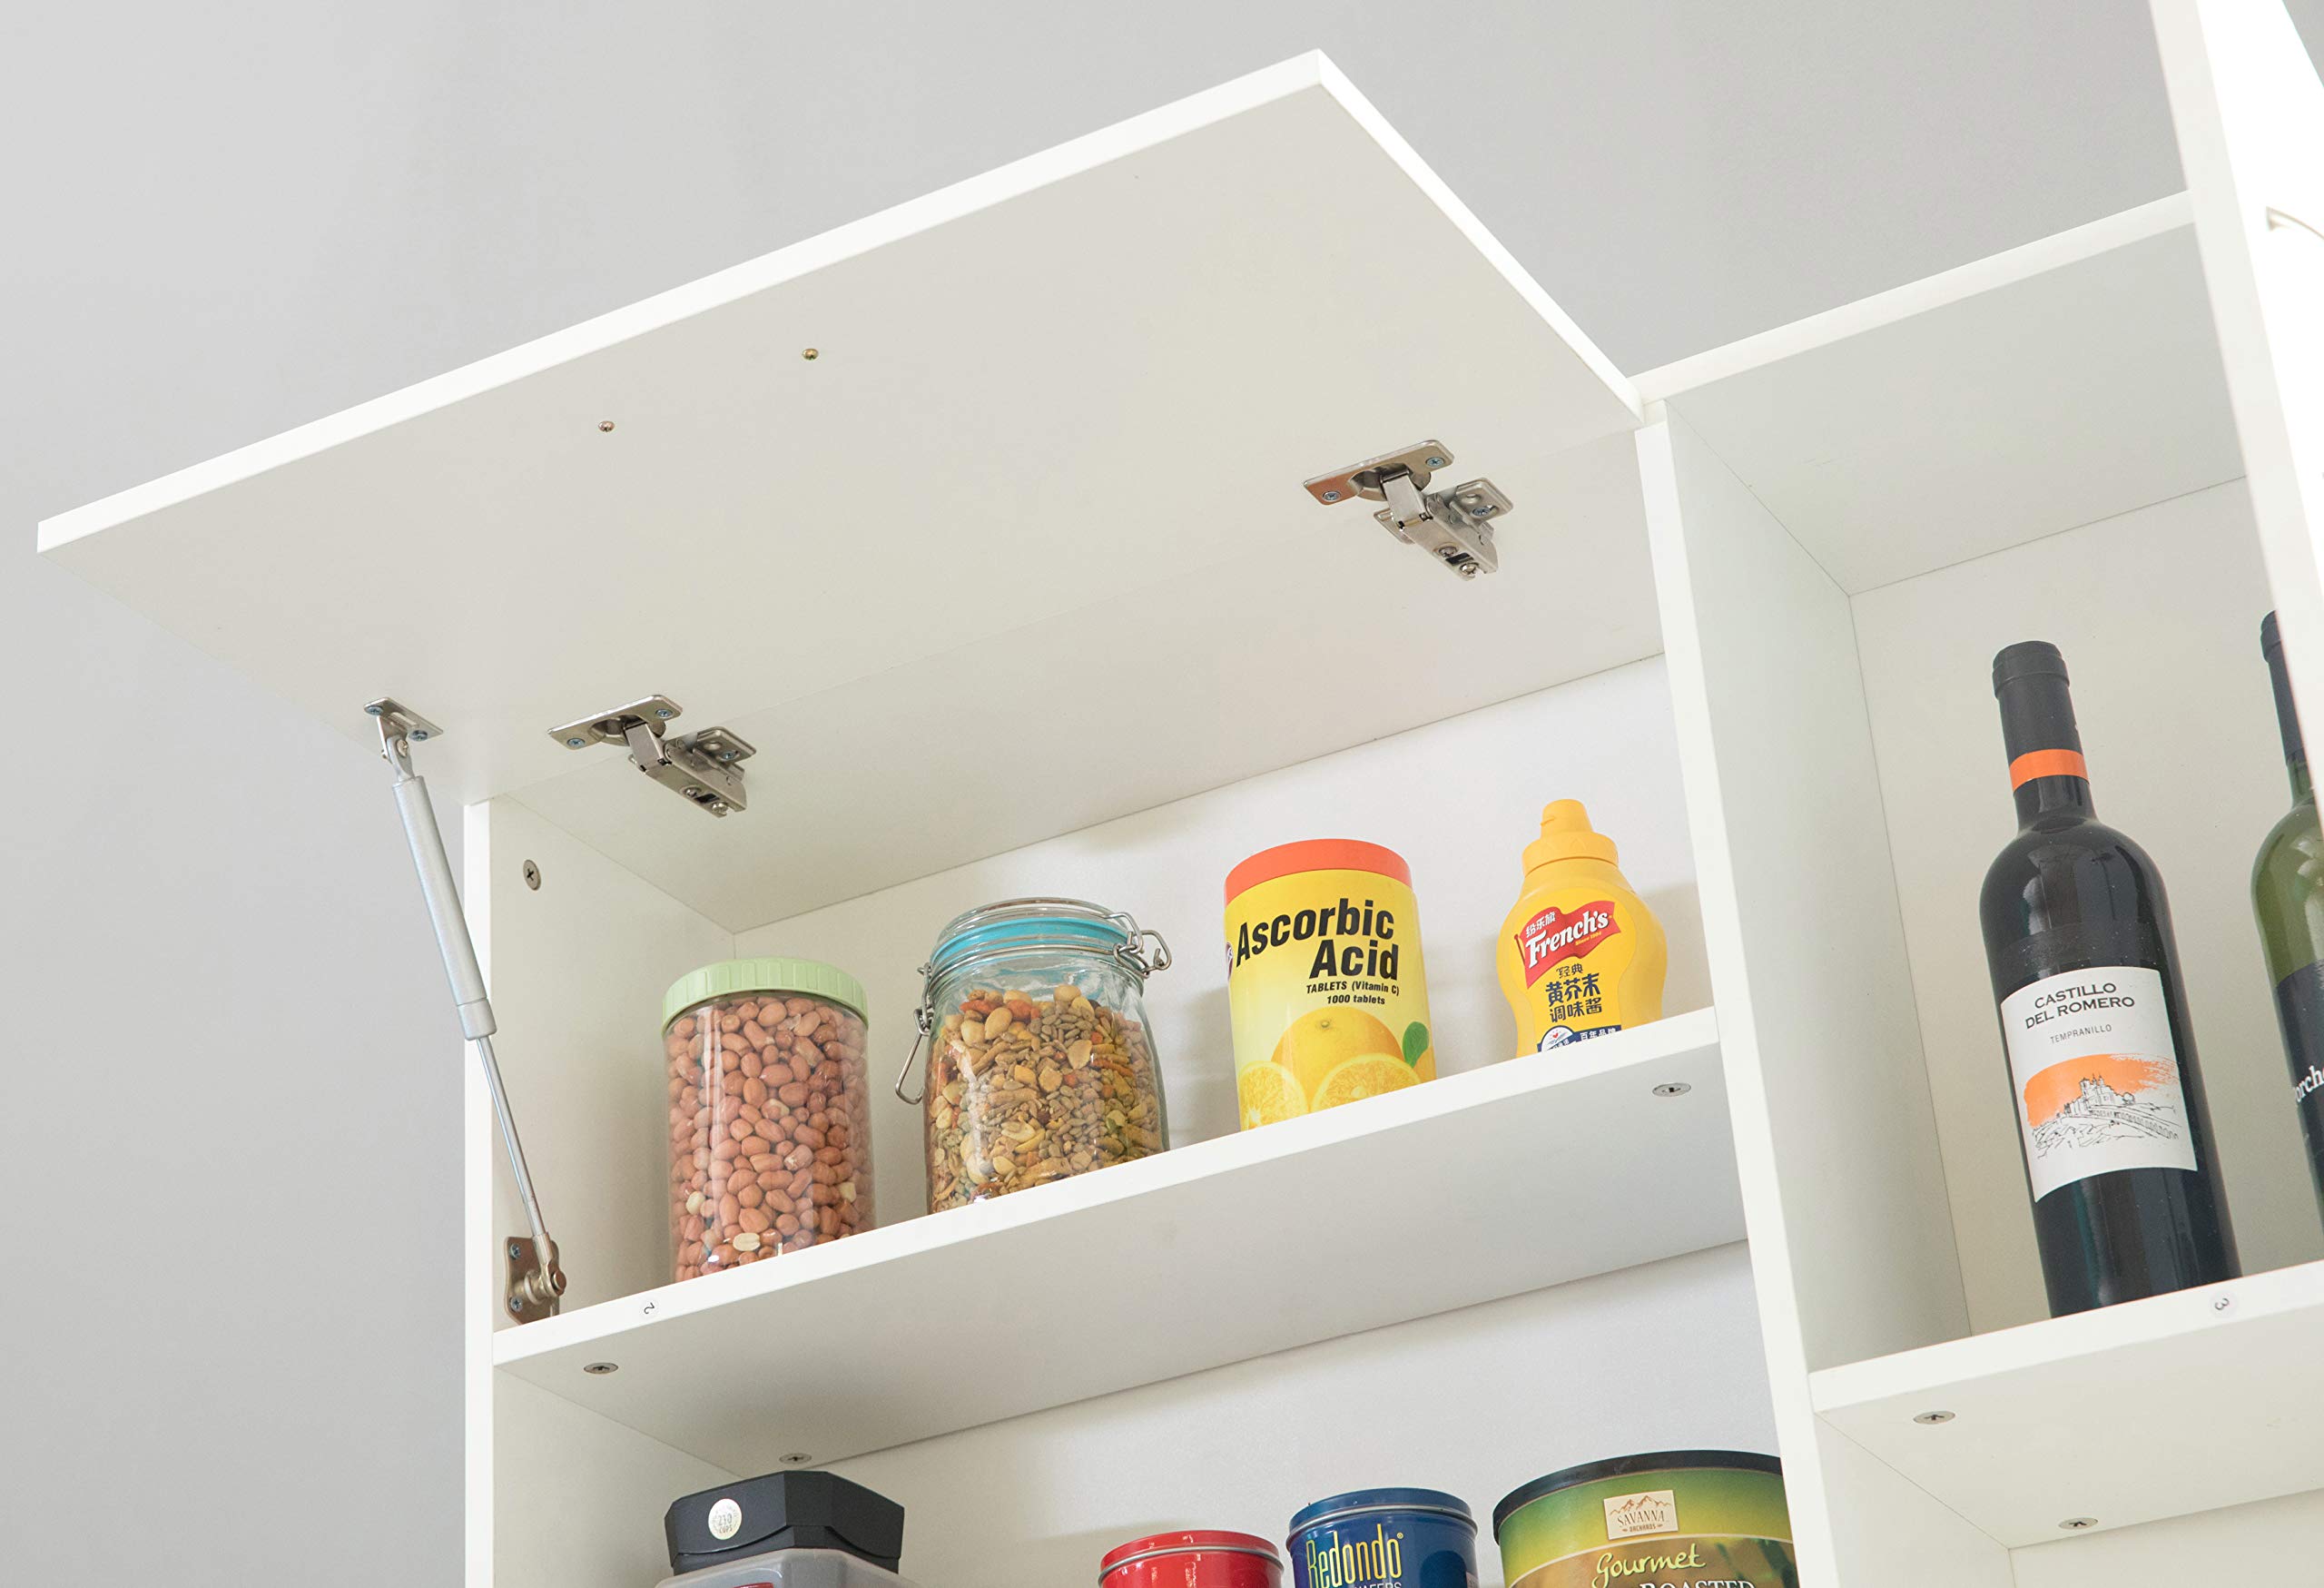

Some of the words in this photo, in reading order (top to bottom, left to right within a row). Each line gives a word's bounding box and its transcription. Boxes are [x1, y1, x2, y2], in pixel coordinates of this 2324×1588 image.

[1236, 898, 1394, 968] Ascorbic
[1525, 911, 1609, 969] French's
[1309, 939, 1399, 981] Acid
[1556, 963, 1583, 979] 经典
[1306, 981, 1347, 994] TABLETS
[1352, 981, 1389, 992] (Vitamin
[1391, 985, 1400, 996] C)
[1327, 995, 1351, 1004] 1000
[1354, 994, 1385, 1005] tablets
[1545, 972, 1600, 1007] 黄芥末
[2034, 982, 2117, 1009] CASTILLO
[1550, 997, 1602, 1022] 调味酱
[2025, 1011, 2054, 1030] DEL
[2057, 997, 2135, 1017] ROMERO
[2050, 1024, 2112, 1044] TEMPRANILLO
[1617, 1510, 1665, 1528] SAVANNA
[1629, 1523, 1657, 1533] ORCHARDS
[1305, 1524, 1403, 1588] Redondo
[1591, 1544, 1707, 1588] Gourmet
